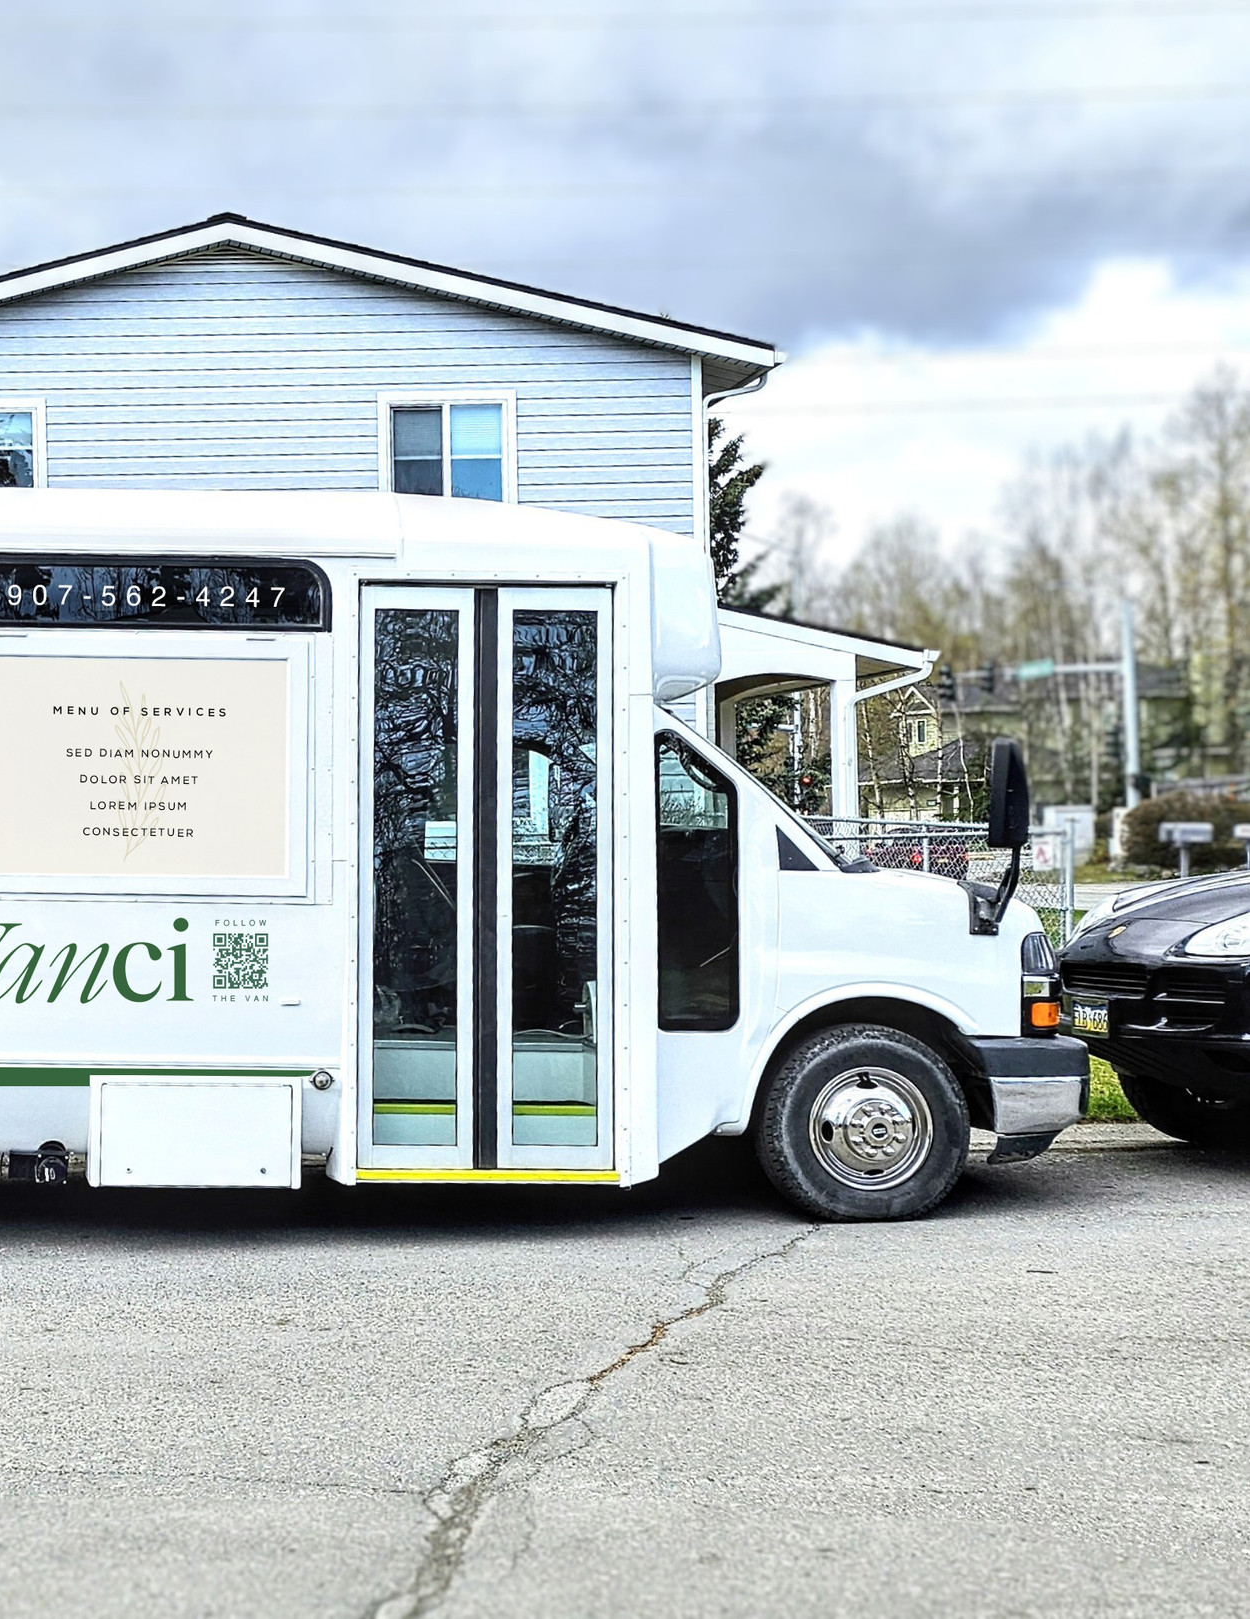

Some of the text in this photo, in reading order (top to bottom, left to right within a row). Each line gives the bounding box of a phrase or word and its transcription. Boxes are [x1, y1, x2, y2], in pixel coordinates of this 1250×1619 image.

[7, 584, 286, 608] 907-562-4247
[52, 705, 227, 718] MENU OF SERVICES
[66, 748, 214, 759] SED DIAM NONUMMY
[79, 774, 199, 785] DOLOR SIT AMET
[89, 800, 188, 811] LOREM IPSUM
[82, 826, 195, 838] CONSECTETUER
[214, 919, 267, 927] FOLLOW
